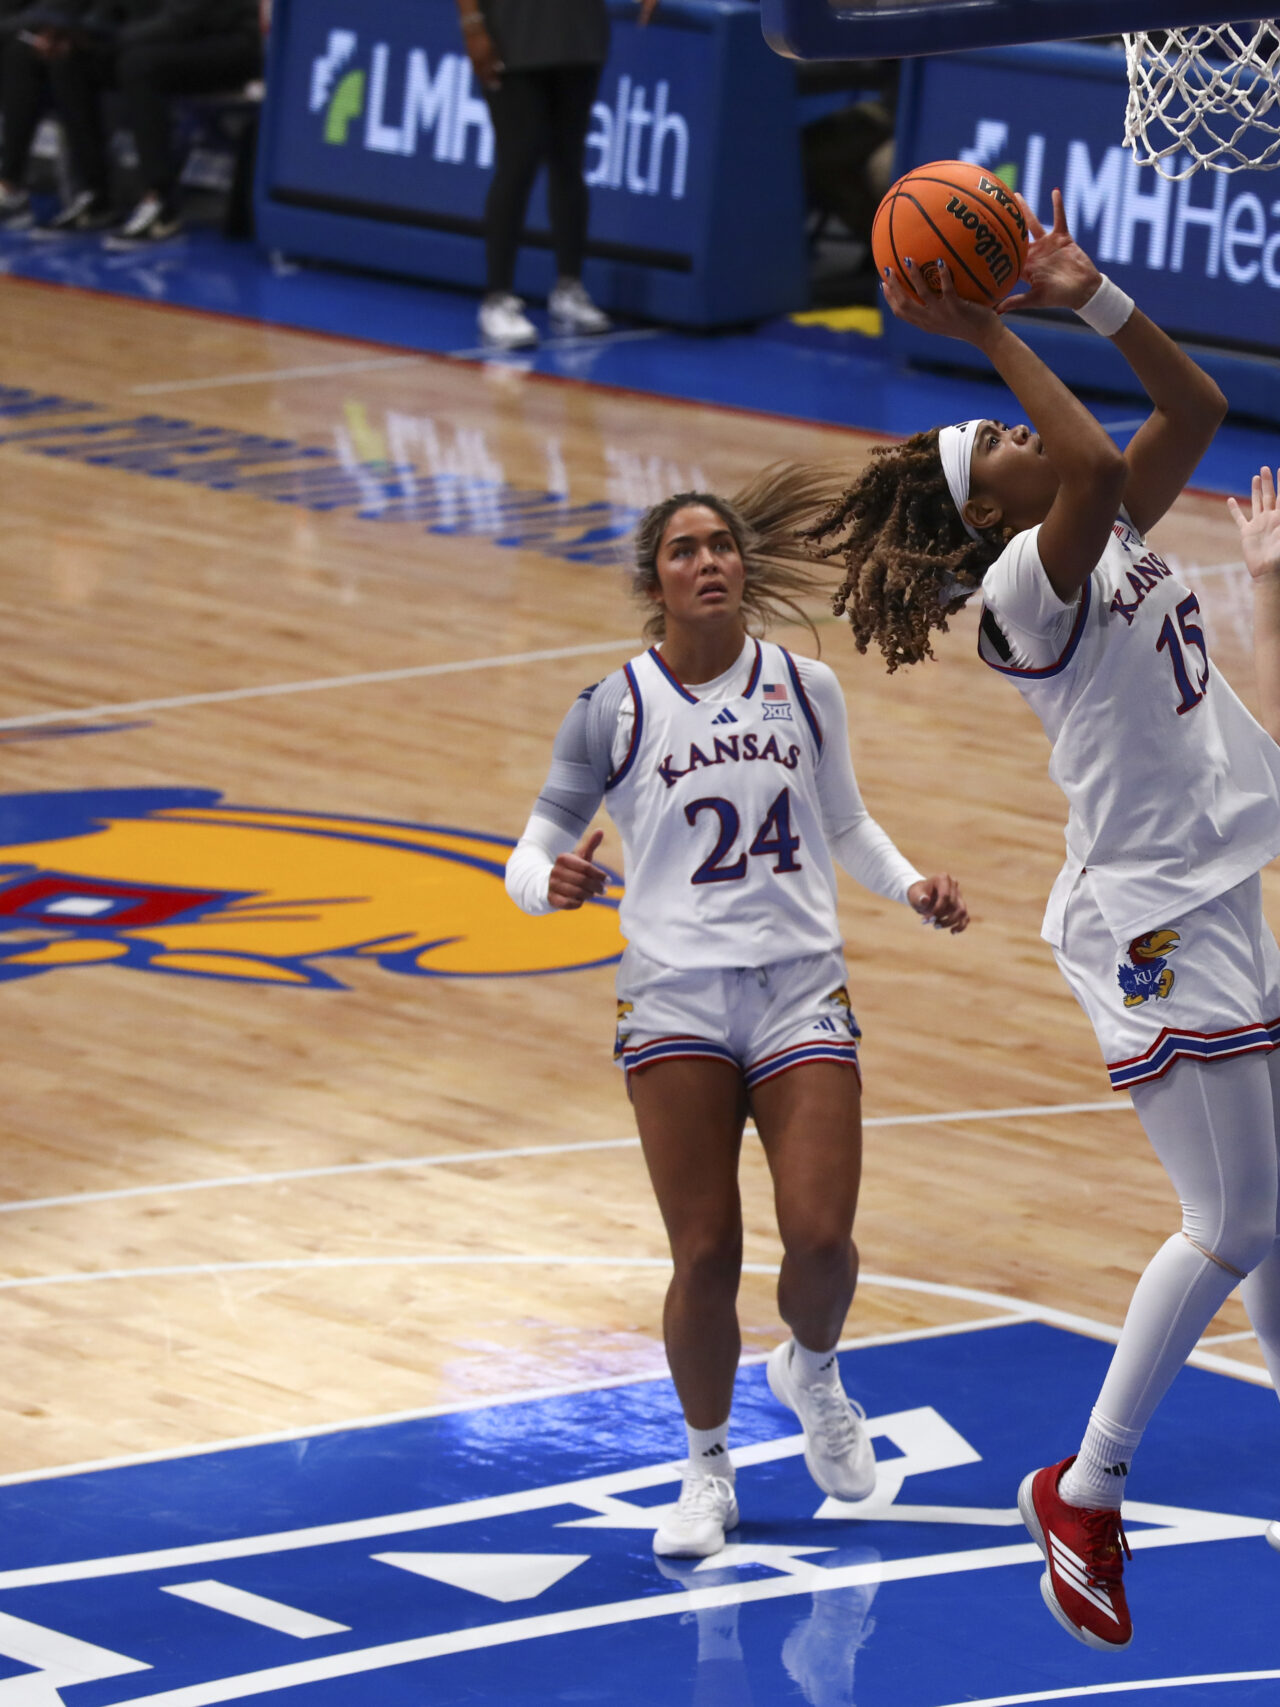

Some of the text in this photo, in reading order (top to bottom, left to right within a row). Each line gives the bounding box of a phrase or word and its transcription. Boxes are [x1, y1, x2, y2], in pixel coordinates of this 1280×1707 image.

[946, 196, 1013, 287] Wilson
[1155, 591, 1210, 716] 15
[657, 733, 801, 789] KANSAS
[683, 786, 803, 886] 24
[1134, 969, 1153, 986] KU
